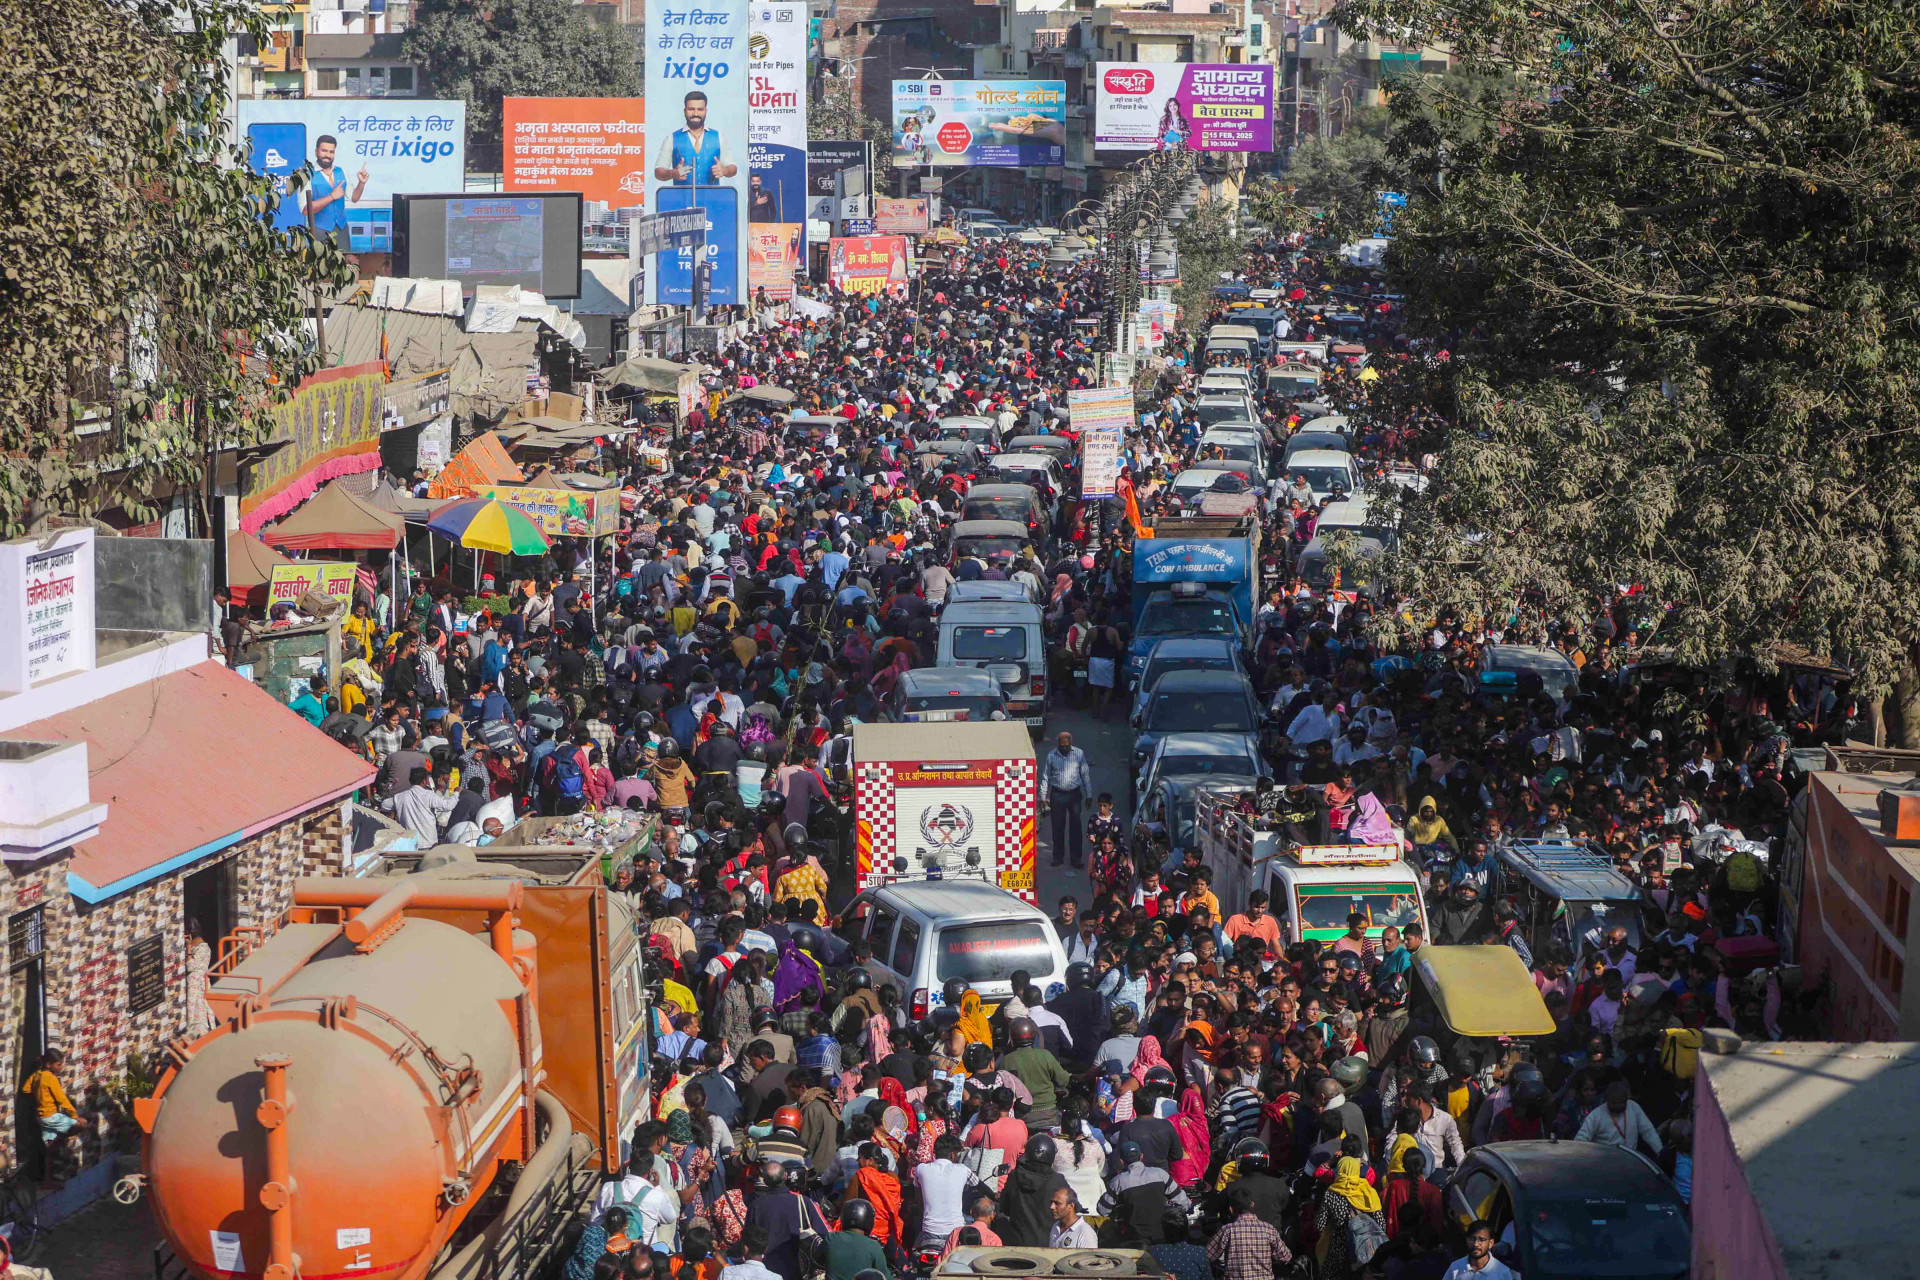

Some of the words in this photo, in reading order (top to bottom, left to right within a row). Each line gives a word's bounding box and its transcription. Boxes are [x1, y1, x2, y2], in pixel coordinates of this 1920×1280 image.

[664, 9, 687, 28] ट्रेन
[688, 9, 730, 26] टिकट
[659, 33, 675, 49] के
[677, 33, 707, 49] लिए
[710, 36, 734, 49] बस
[663, 56, 729, 85] ixigo
[775, 61, 794, 71] Pipes
[1192, 69, 1264, 83] सामान्य
[750, 76, 775, 91] SL
[907, 84, 923, 93] SBI
[1190, 82, 1267, 97] अध्ययन
[749, 92, 797, 108] UPATI
[976, 85, 1019, 105] गोल्ड
[1024, 85, 1059, 105] लोन
[1200, 105, 1217, 116] बैच
[1220, 108, 1254, 117] प्रारम्भ
[338, 116, 361, 134] ट्रेन
[364, 116, 403, 132] टिकट
[406, 116, 423, 132] के
[425, 116, 454, 132] लिए
[514, 122, 549, 137] अमृता
[551, 122, 601, 134] अस्पताल
[603, 120, 645, 134] फरीदाब
[1219, 132, 1235, 140] FEB,
[355, 139, 388, 157] बस
[391, 135, 454, 163] ixigo
[514, 143, 530, 155] एवं
[531, 145, 555, 155] माता
[557, 143, 622, 158] अमृतानंदमयी
[624, 145, 642, 155] मठ
[749, 153, 785, 162] UGHEST
[514, 166, 548, 179] महाकुंभ
[549, 166, 570, 176] मेला
[570, 168, 594, 176] 2025
[821, 205, 831, 213] 12
[849, 204, 859, 213] 26
[1145, 551, 1169, 568] TEAM
[1155, 565, 1175, 573] COW
[1176, 563, 1225, 573] AMBULANCE
[273, 575, 312, 598] महावीर
[328, 578, 352, 596] ढाबा
[942, 771, 955, 780] तथा
[955, 771, 974, 780] आपात
[976, 768, 993, 780] सेवायें
[1009, 872, 1019, 880] UP
[1021, 872, 1031, 880] 32
[1007, 880, 1032, 888] EG8749
